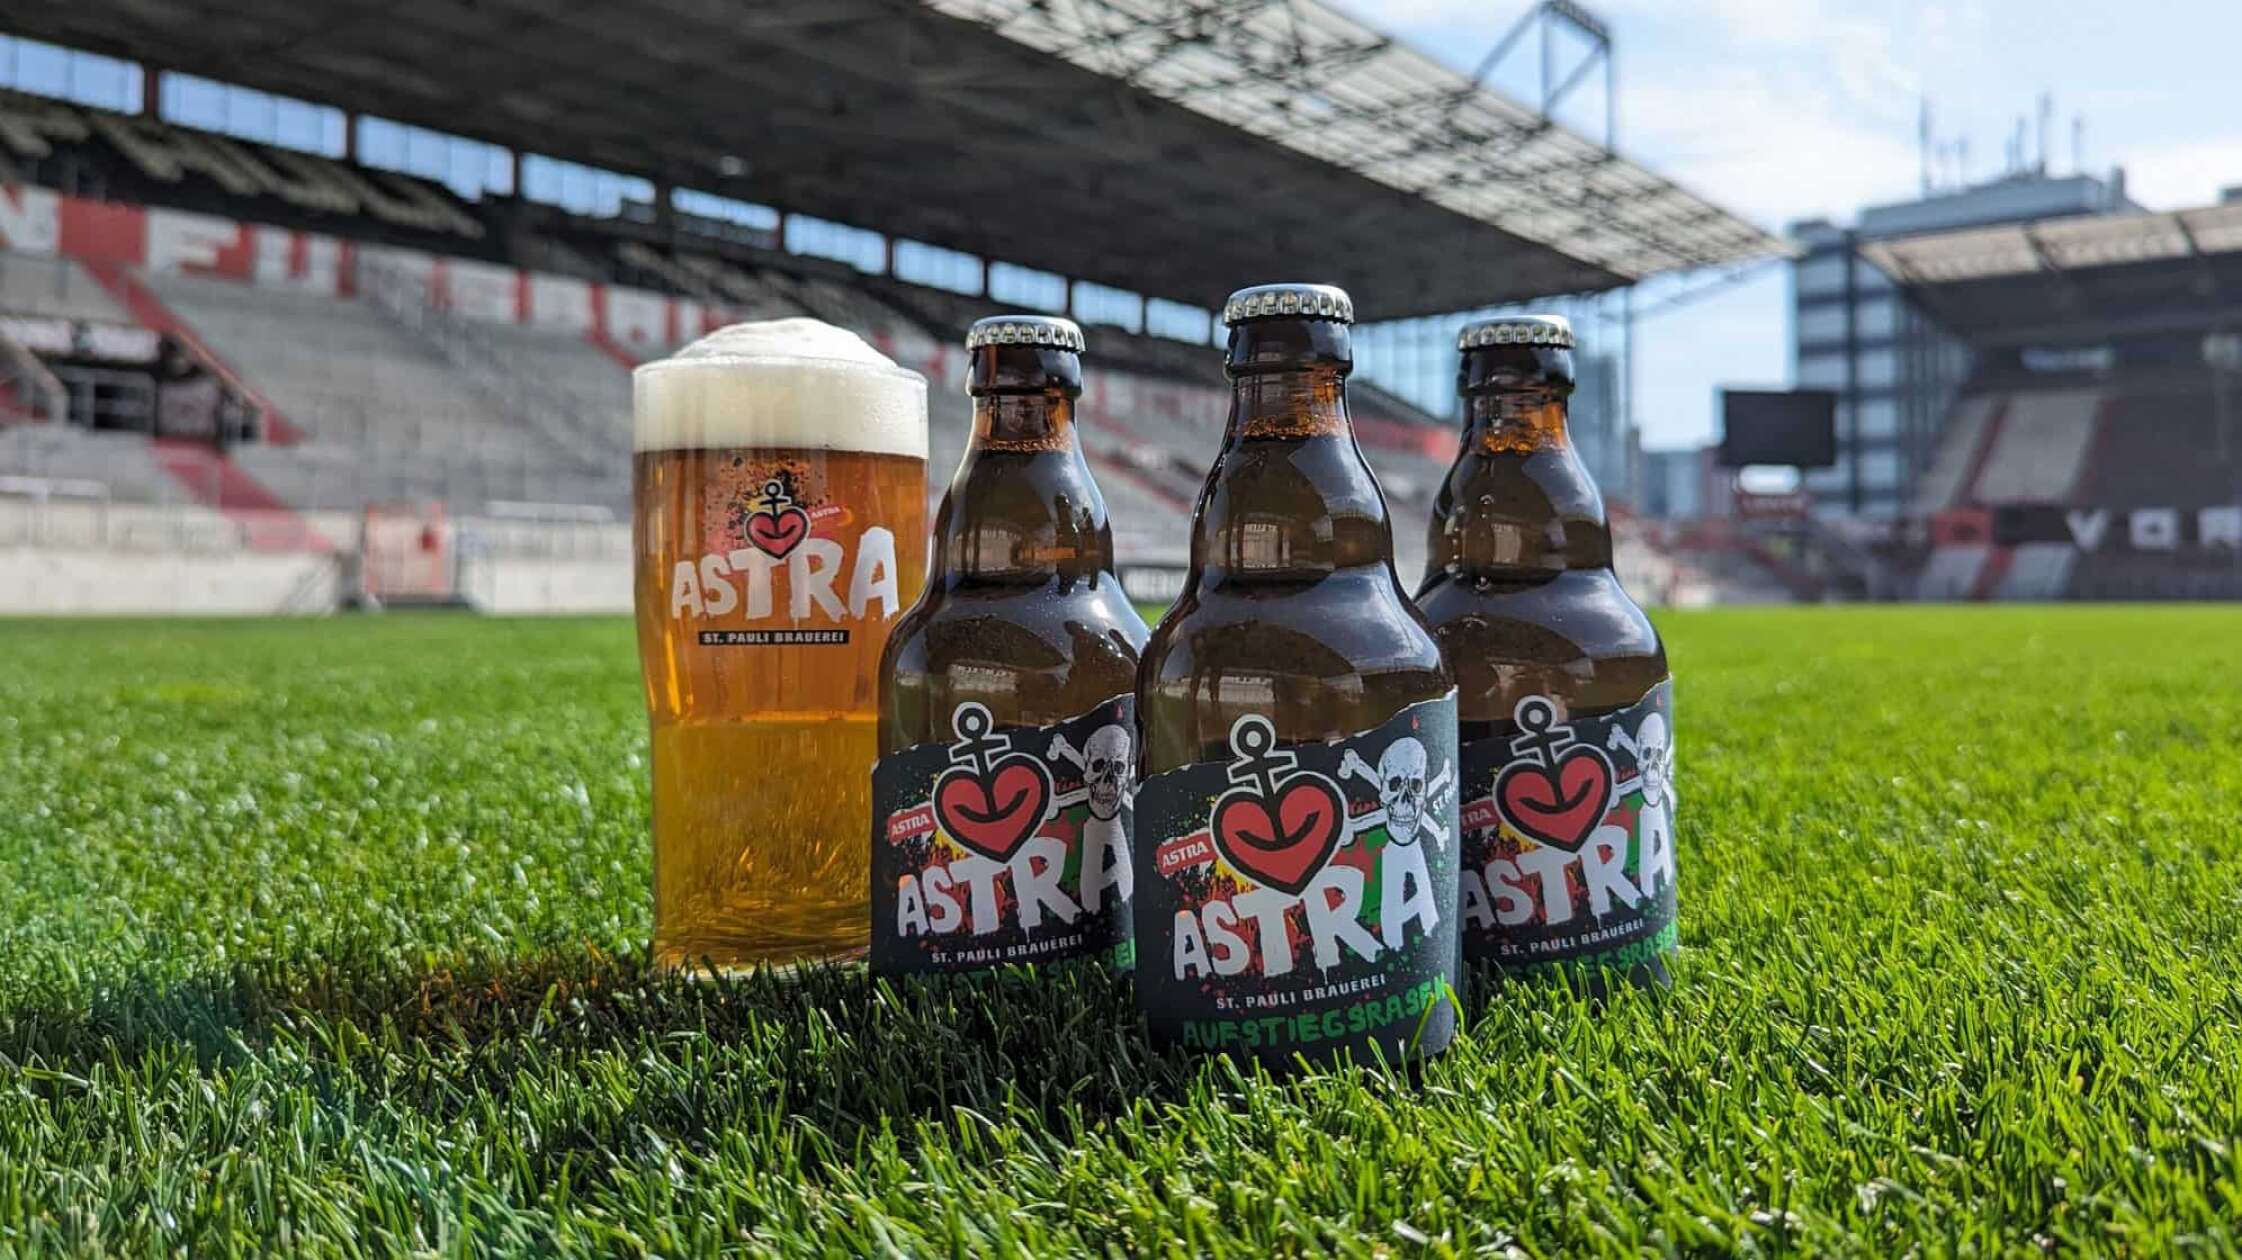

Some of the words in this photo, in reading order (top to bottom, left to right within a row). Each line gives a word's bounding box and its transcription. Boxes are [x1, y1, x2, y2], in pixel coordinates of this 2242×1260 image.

[671, 526, 899, 623] ASTRA
[703, 632, 724, 644] ST.
[728, 632, 770, 643] PAULI
[774, 631, 845, 643] BRAUEREI
[890, 812, 930, 835] ASTRA
[1162, 841, 1210, 868] ASTRA
[1460, 803, 1674, 931] ASTRA
[897, 820, 1134, 937] ASTRA
[1174, 843, 1440, 980] ASTRA
[931, 952, 952, 964] ST.
[957, 948, 1000, 963] PAULI
[1006, 934, 1083, 957] BRAUEREI
[1500, 943, 1524, 956] ST.
[1530, 936, 1576, 954] PAULI
[1581, 918, 1644, 945] BRAUEREI
[1182, 972, 1447, 1050] AUFSTIEGSRASEN
[1215, 996, 1241, 1010] ST.
[1246, 988, 1297, 1008] PAULI
[1302, 974, 1387, 1002] BRAUEREI
